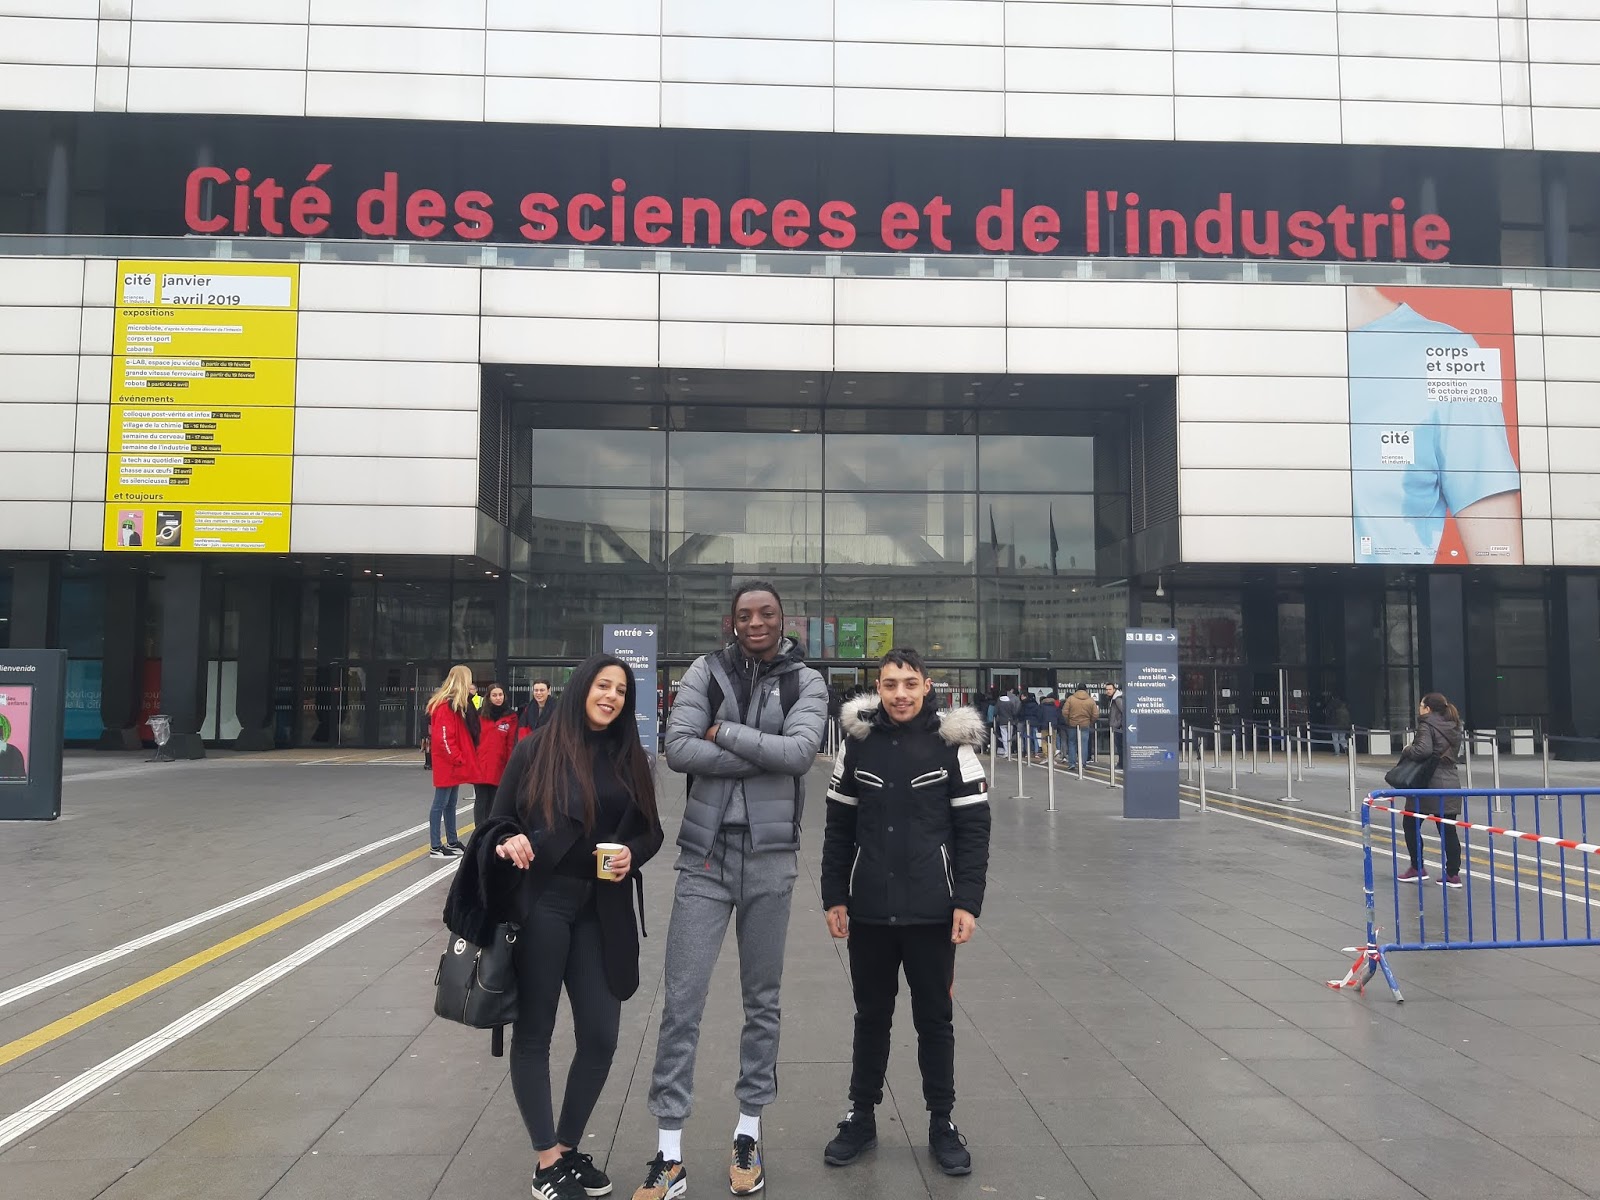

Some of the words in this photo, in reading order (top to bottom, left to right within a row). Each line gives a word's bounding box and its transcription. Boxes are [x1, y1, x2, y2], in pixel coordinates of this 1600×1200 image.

[184, 163, 332, 237] Cité
[356, 171, 494, 241] des
[519, 178, 858, 249] sciences
[880, 195, 952, 252] et
[976, 188, 1060, 253] de
[1086, 191, 1451, 260] l'industrie
[124, 273, 152, 286] cité
[162, 273, 212, 288] janvier
[173, 293, 204, 305] avril
[207, 295, 241, 306] 2019
[123, 308, 175, 318] expositions
[1426, 347, 1469, 360] corps
[1426, 360, 1441, 372] et
[1446, 360, 1486, 375] sport
[119, 395, 175, 403] événements
[1450, 395, 1476, 403] janvier
[1381, 430, 1410, 444] cité
[151, 457, 182, 465] quotidien
[125, 492, 164, 502] toujours
[613, 627, 642, 637] entrée
[626, 654, 649, 663] congrès
